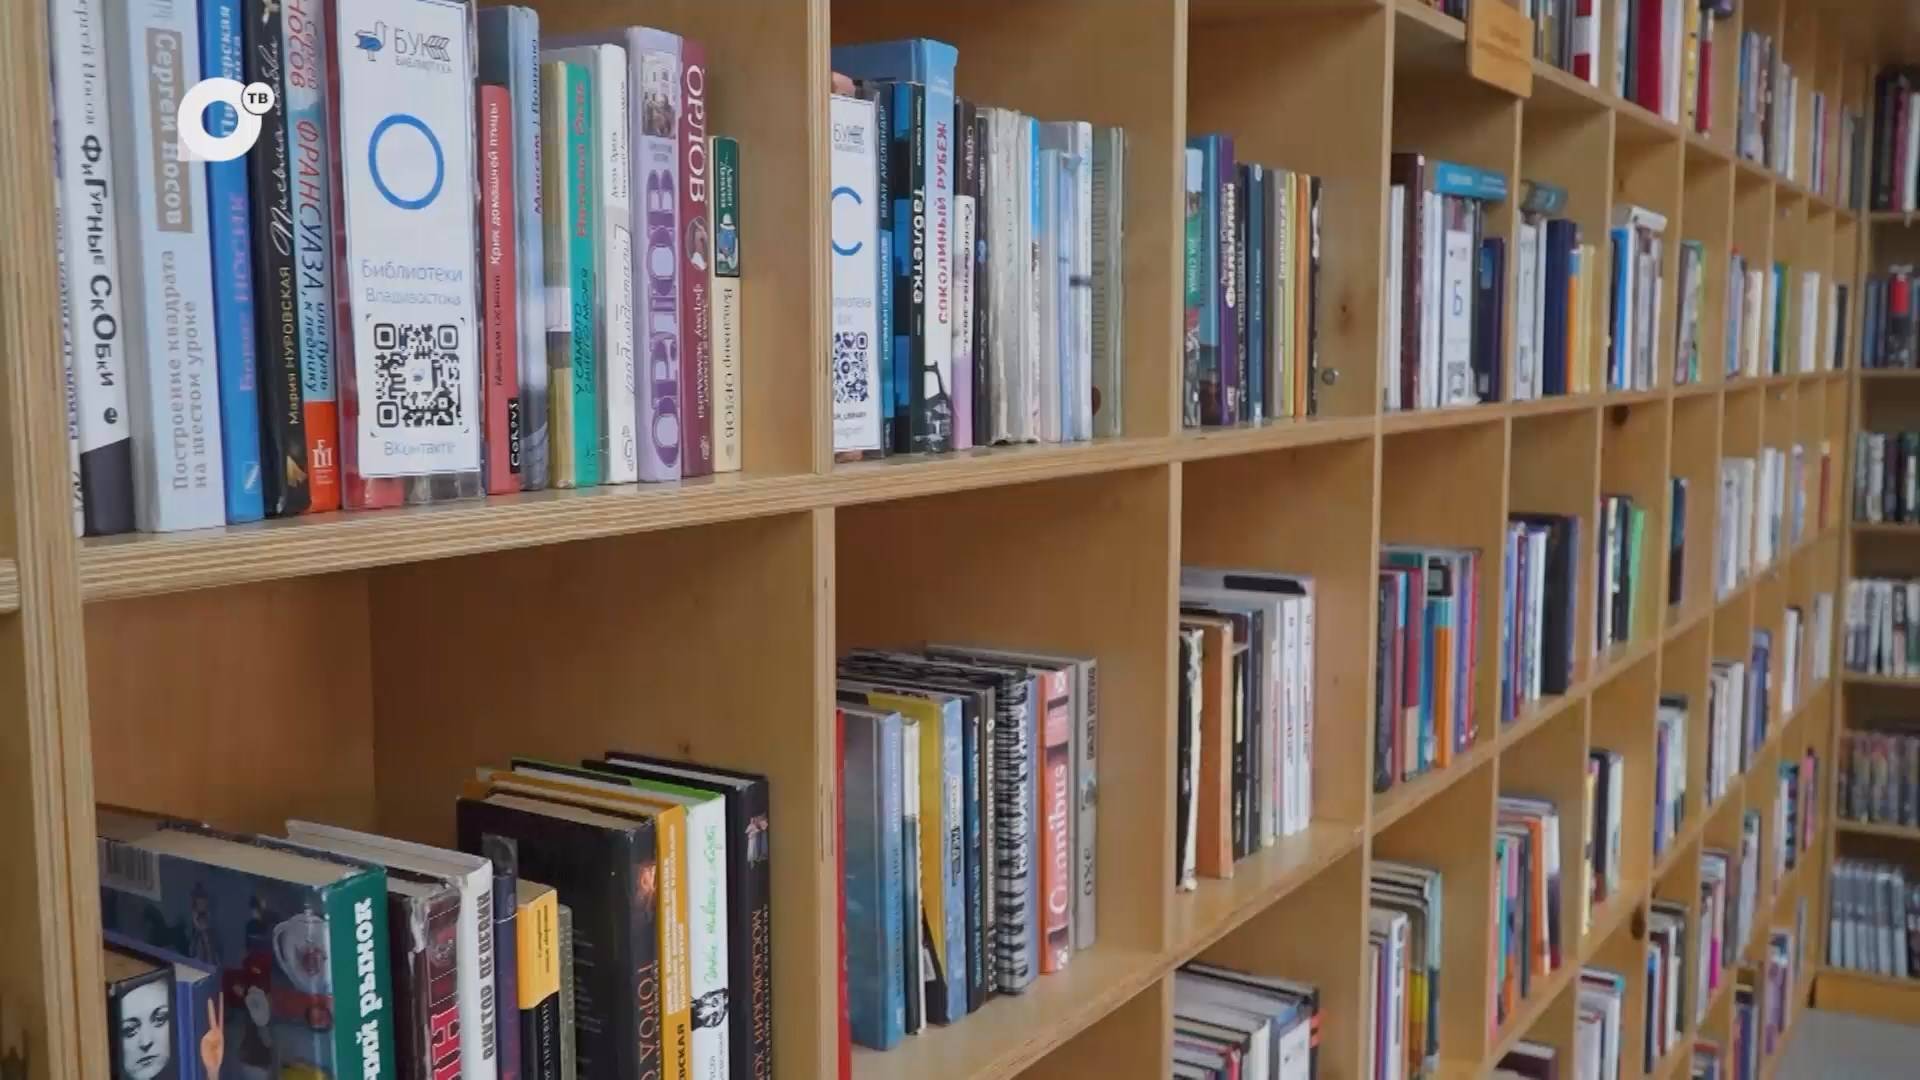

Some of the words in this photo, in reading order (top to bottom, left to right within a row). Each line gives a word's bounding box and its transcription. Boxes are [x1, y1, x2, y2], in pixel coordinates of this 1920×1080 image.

[686, 63, 707, 203] ОРЛОВ
[361, 259, 463, 282] Библиотеки
[911, 186, 925, 304] Таблетка
[161, 250, 182, 353] квадрата
[186, 301, 203, 370] уроке
[279, 266, 297, 367] НУРОВСКАЯ
[165, 356, 187, 491] Построение
[189, 375, 206, 459] шестом
[287, 373, 302, 424] Мария
[195, 463, 207, 488] на
[354, 897, 383, 1018] рынок
[354, 1019, 383, 1080] ий
[676, 1023, 685, 1080] ВСКАЯ
